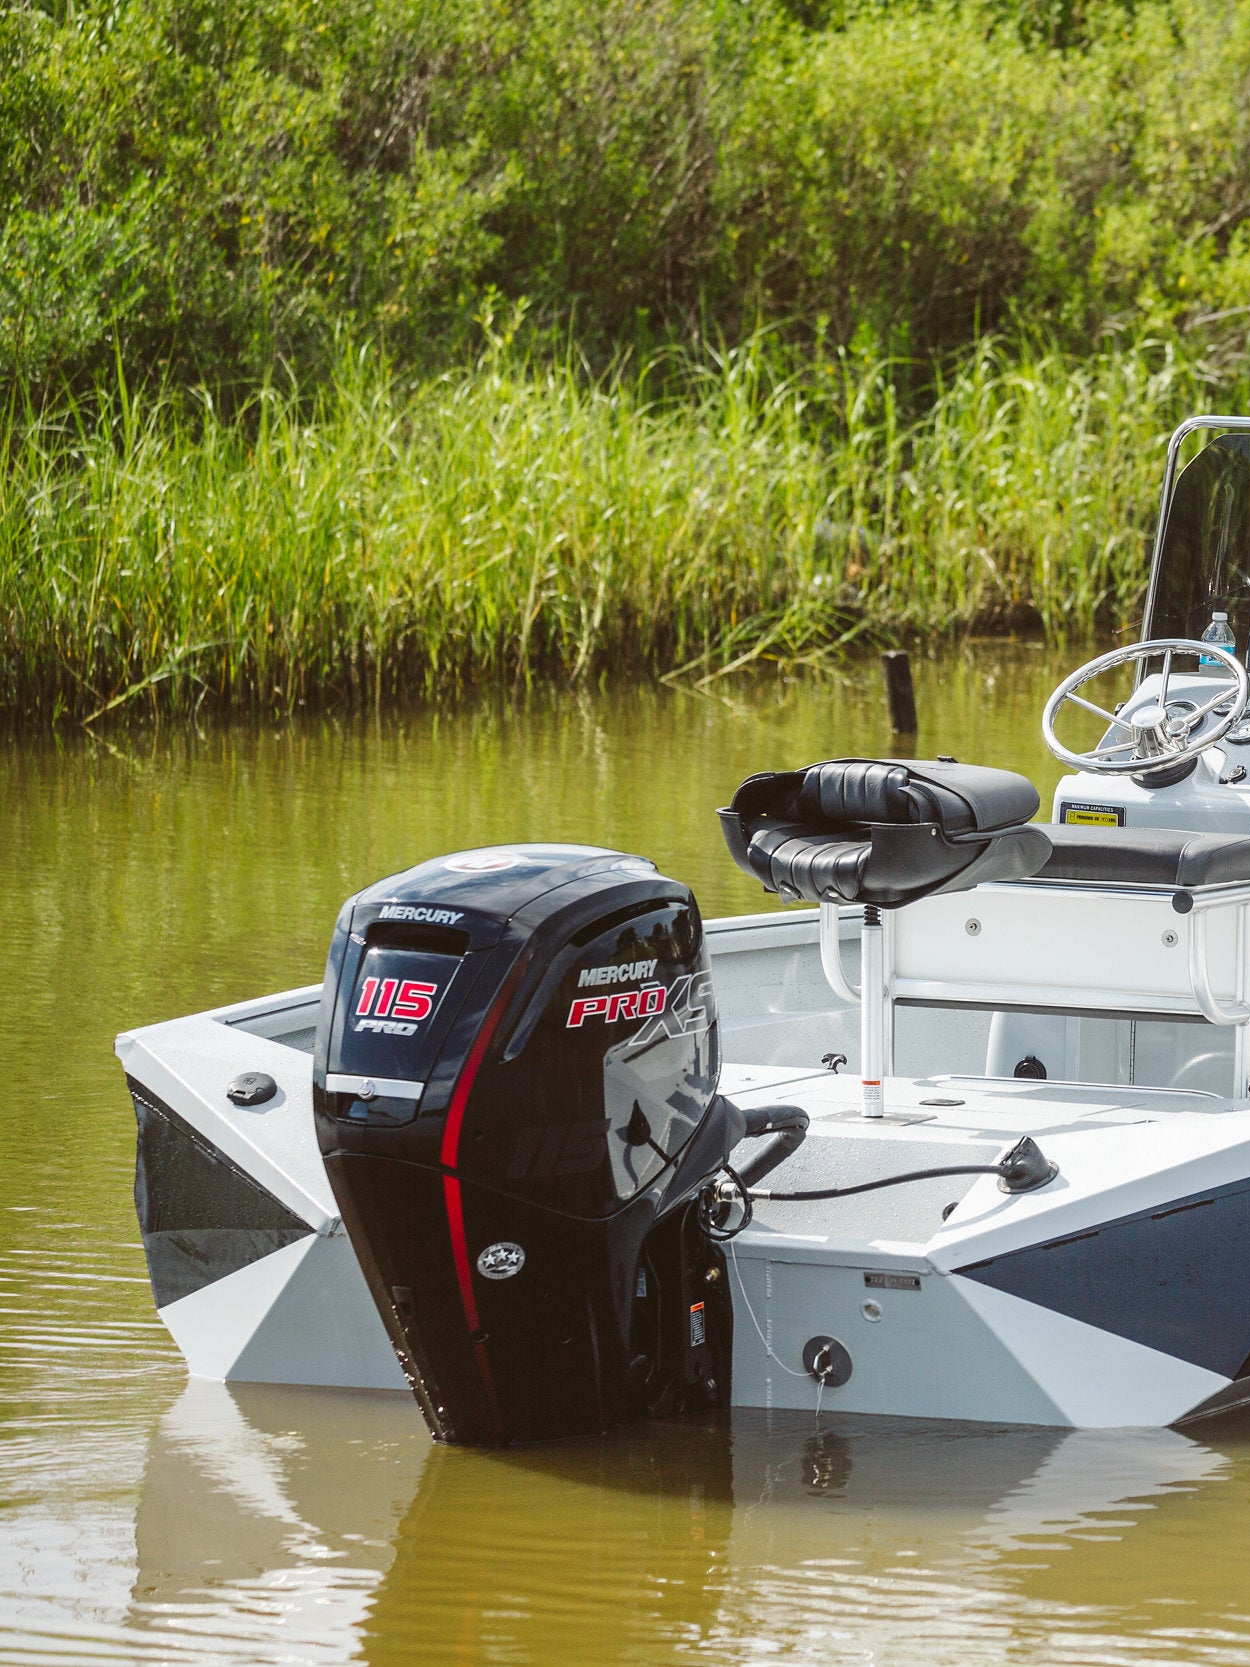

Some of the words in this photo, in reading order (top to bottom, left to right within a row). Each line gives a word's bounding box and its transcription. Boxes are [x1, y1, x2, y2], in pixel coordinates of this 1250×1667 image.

[378, 905, 464, 925] MERCURY
[577, 958, 658, 988] MERCURY
[355, 976, 438, 1020] 115
[565, 985, 668, 1029] PRO
[354, 1019, 419, 1037] PRO
